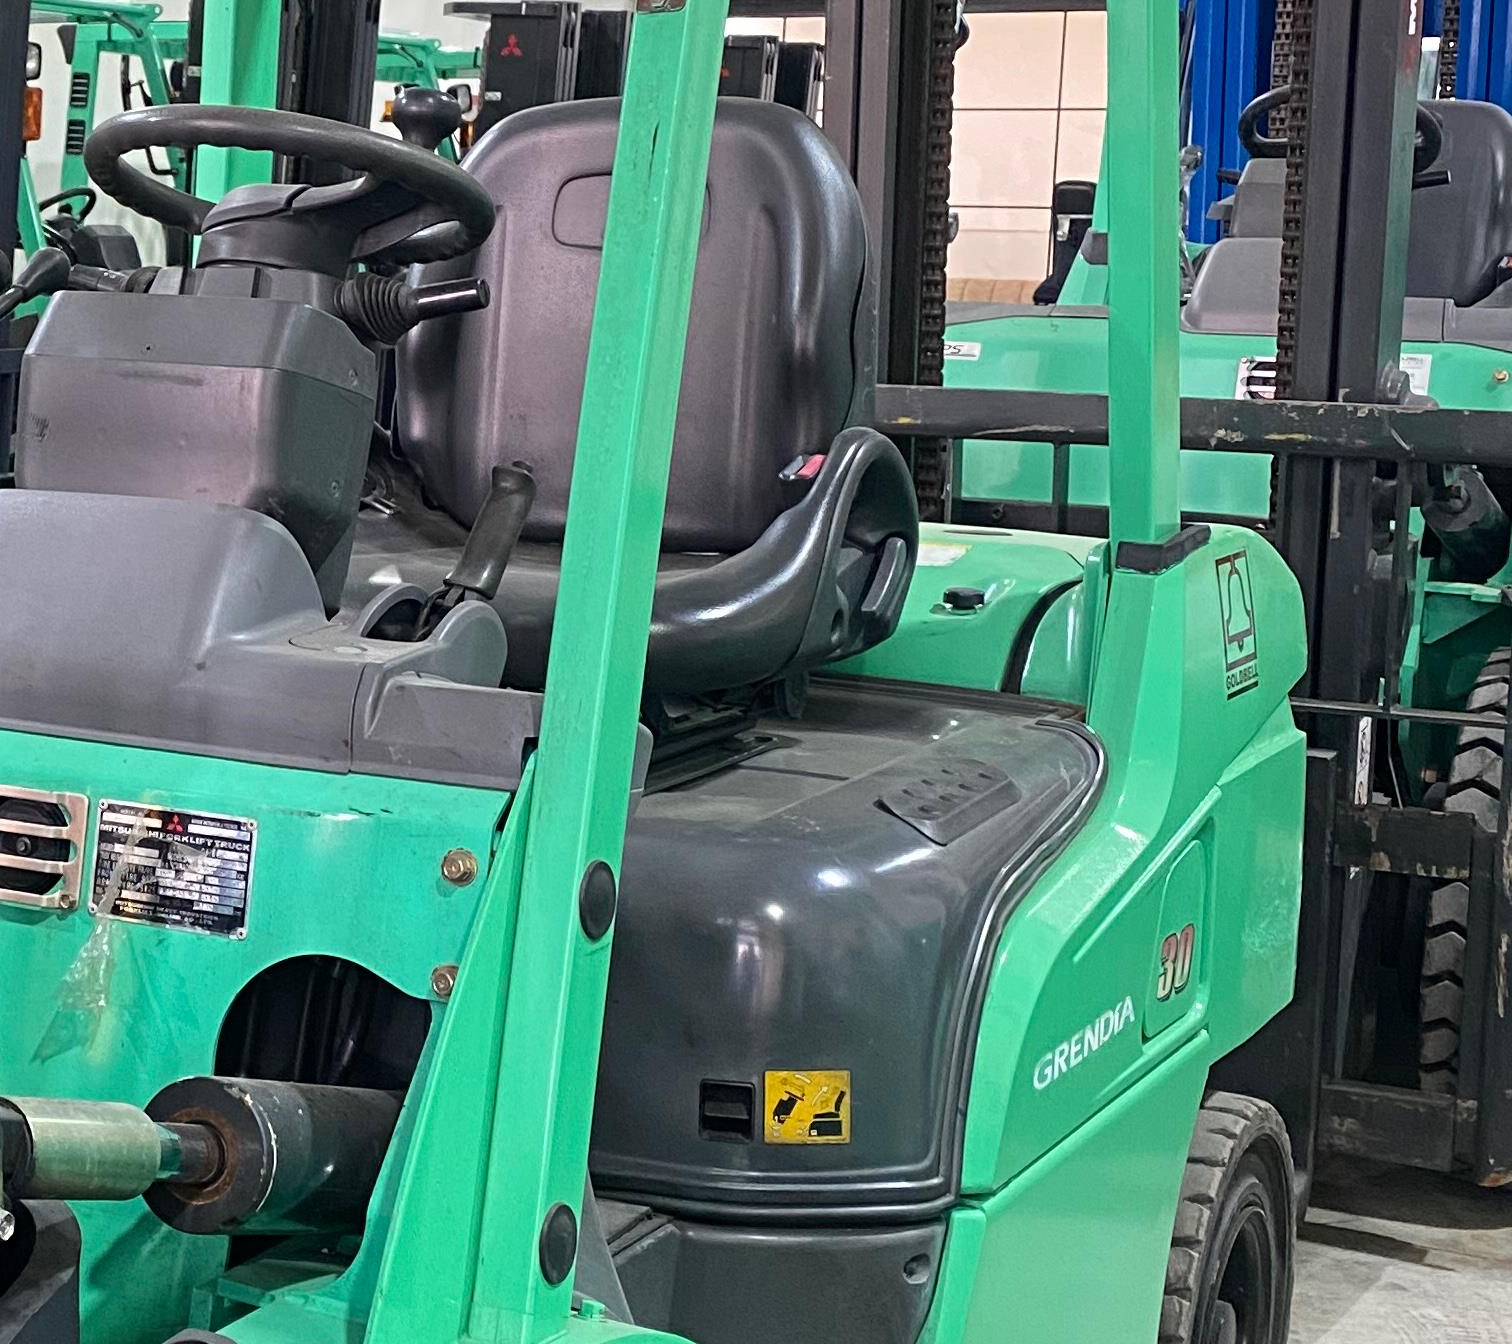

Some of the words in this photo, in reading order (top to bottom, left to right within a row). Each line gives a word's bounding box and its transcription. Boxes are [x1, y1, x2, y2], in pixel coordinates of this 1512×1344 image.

[1227, 663, 1259, 691] GOLDBELL
[100, 823, 159, 838] MITSUHI
[214, 839, 250, 852] TRUCK
[1157, 923, 1196, 1002] 30
